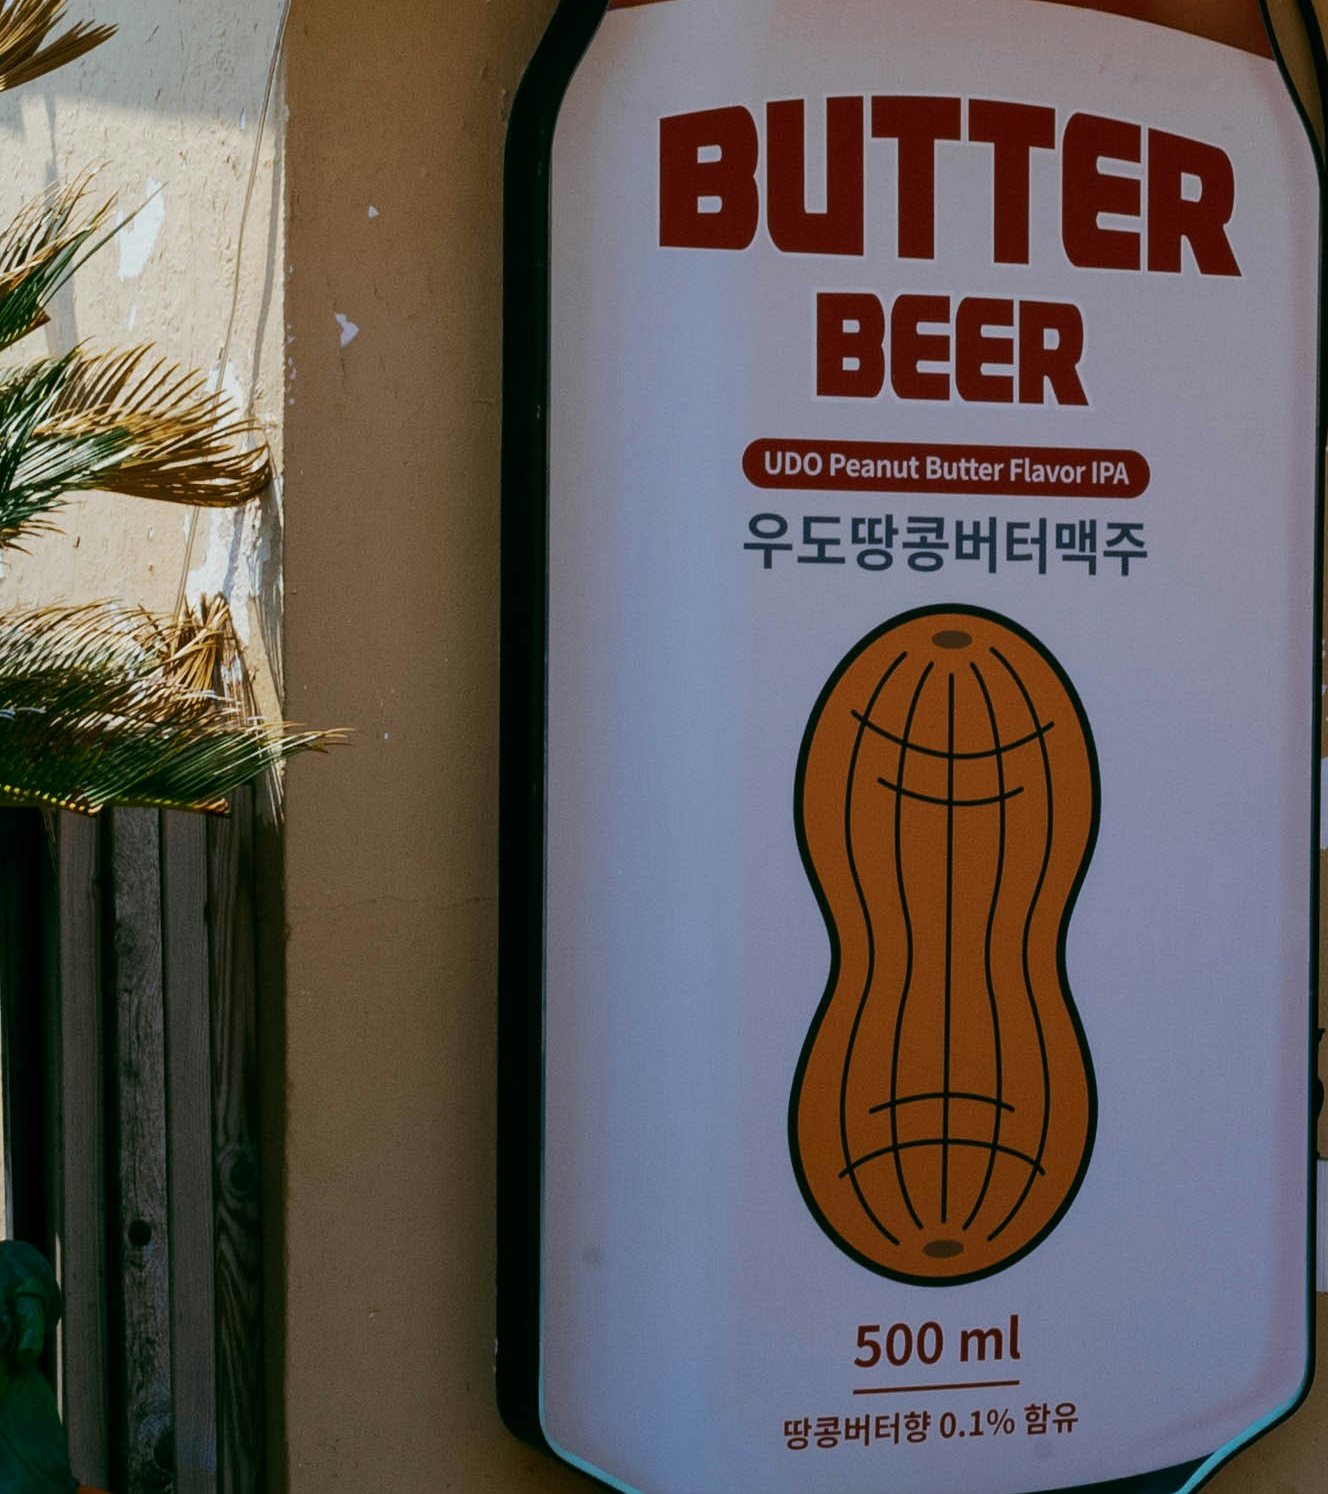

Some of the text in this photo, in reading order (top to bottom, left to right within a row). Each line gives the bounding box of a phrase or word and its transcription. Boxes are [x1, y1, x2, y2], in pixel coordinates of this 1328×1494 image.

[658, 95, 1242, 277] BUTTER
[816, 292, 1089, 406] BEER
[764, 450, 1130, 485] UDO Peanut Butter Flavor IPA
[743, 512, 1148, 577] 우도땅콩버터맥주
[853, 1314, 1022, 1368] 500 ml
[783, 1402, 1079, 1451] 땅콩버터향 0.1% 함유
